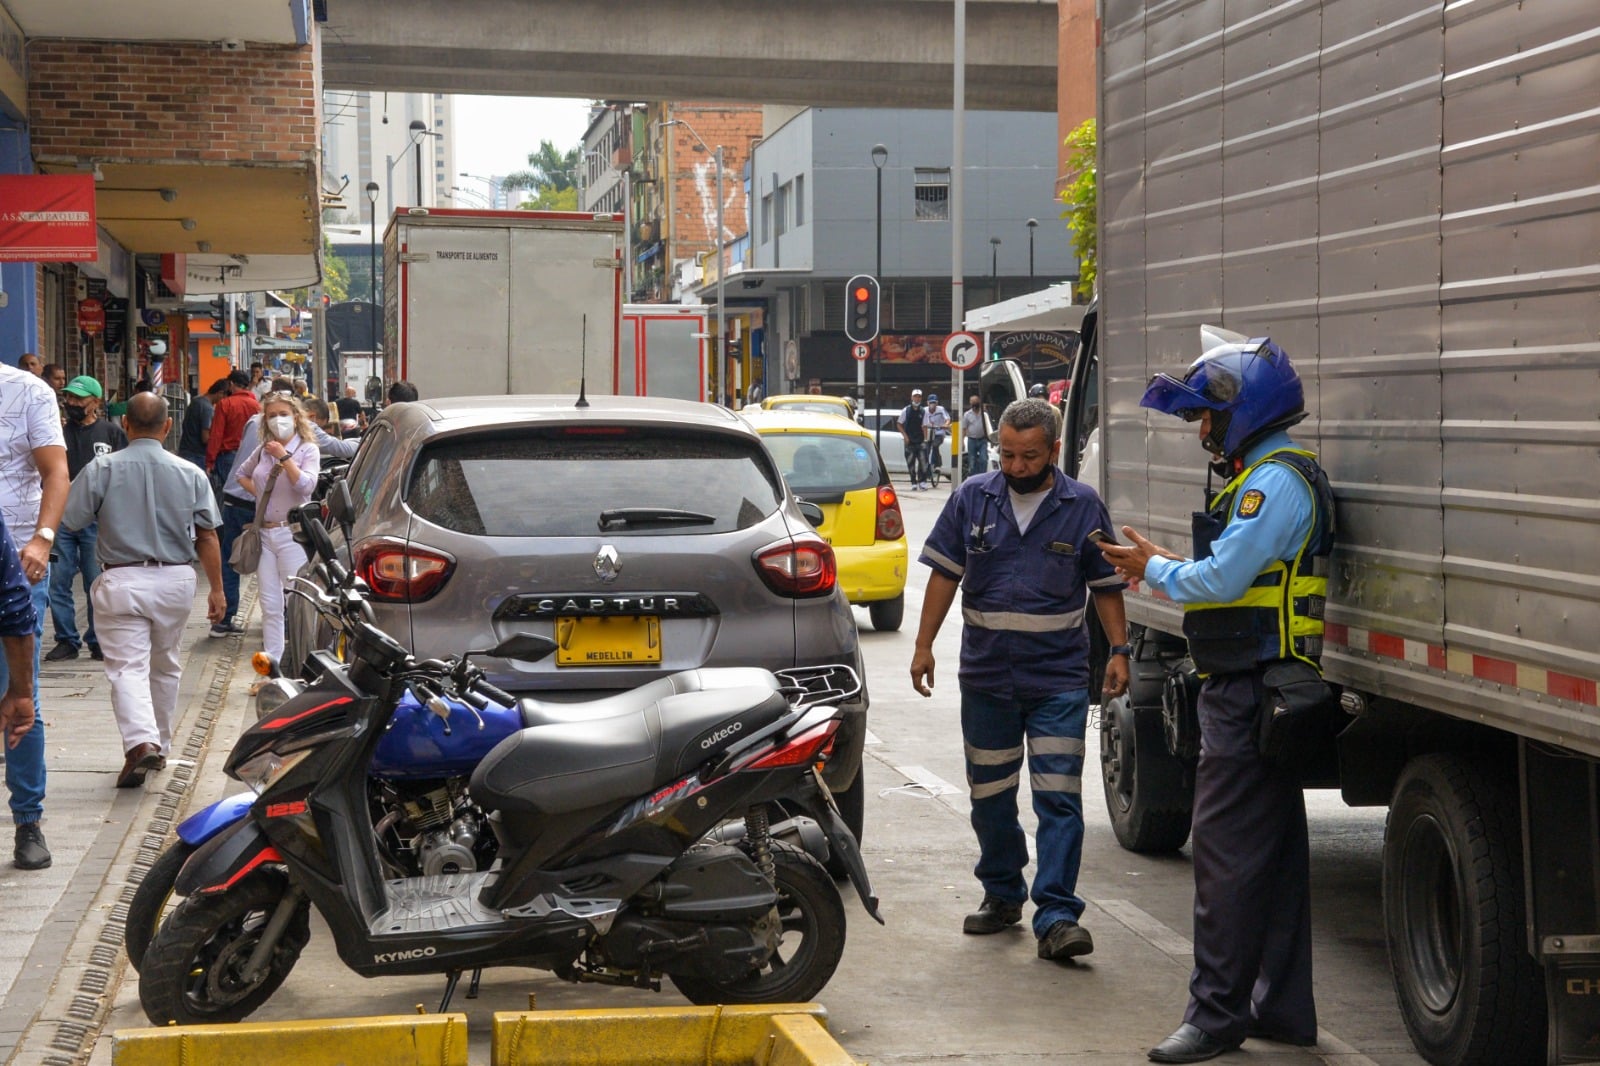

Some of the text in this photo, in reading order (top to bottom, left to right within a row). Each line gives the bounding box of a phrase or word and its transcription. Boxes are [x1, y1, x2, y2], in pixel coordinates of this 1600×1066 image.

[436, 251, 498, 261] TRANSPORTE DE ALIMENTOS
[1001, 333, 1068, 350] BOLIVARPAN
[538, 598, 680, 611] CAPTUR
[586, 651, 633, 661] MEDELLIN
[701, 721, 743, 749] auteco
[374, 946, 437, 964] KYMCO
